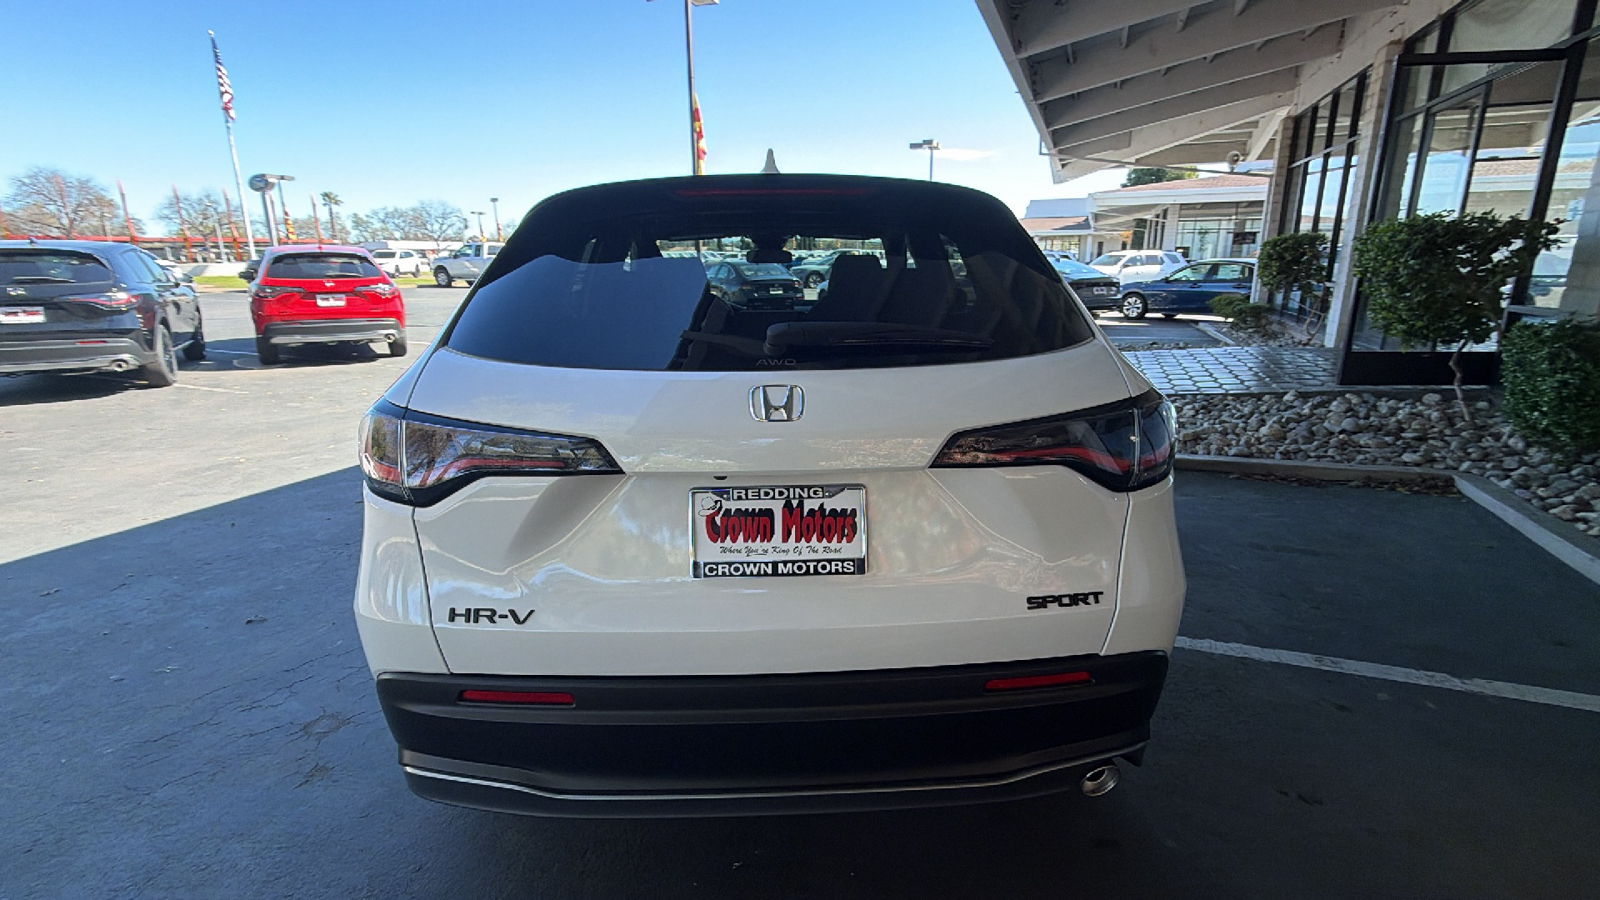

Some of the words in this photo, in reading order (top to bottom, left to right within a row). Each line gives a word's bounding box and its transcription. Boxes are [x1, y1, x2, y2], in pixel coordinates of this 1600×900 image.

[756, 358, 797, 366] AWD
[733, 487, 824, 500] REDDING
[705, 502, 775, 544] Crown
[781, 500, 858, 544] Motors
[719, 546, 742, 554] Where
[771, 546, 790, 556] King
[792, 546, 803, 555] Of
[805, 545, 819, 554] The
[821, 546, 842, 554] Road
[704, 563, 772, 576] CROWN
[777, 560, 855, 574] MOTORS
[1026, 591, 1104, 610] SPORT
[448, 607, 535, 625] HR-V
